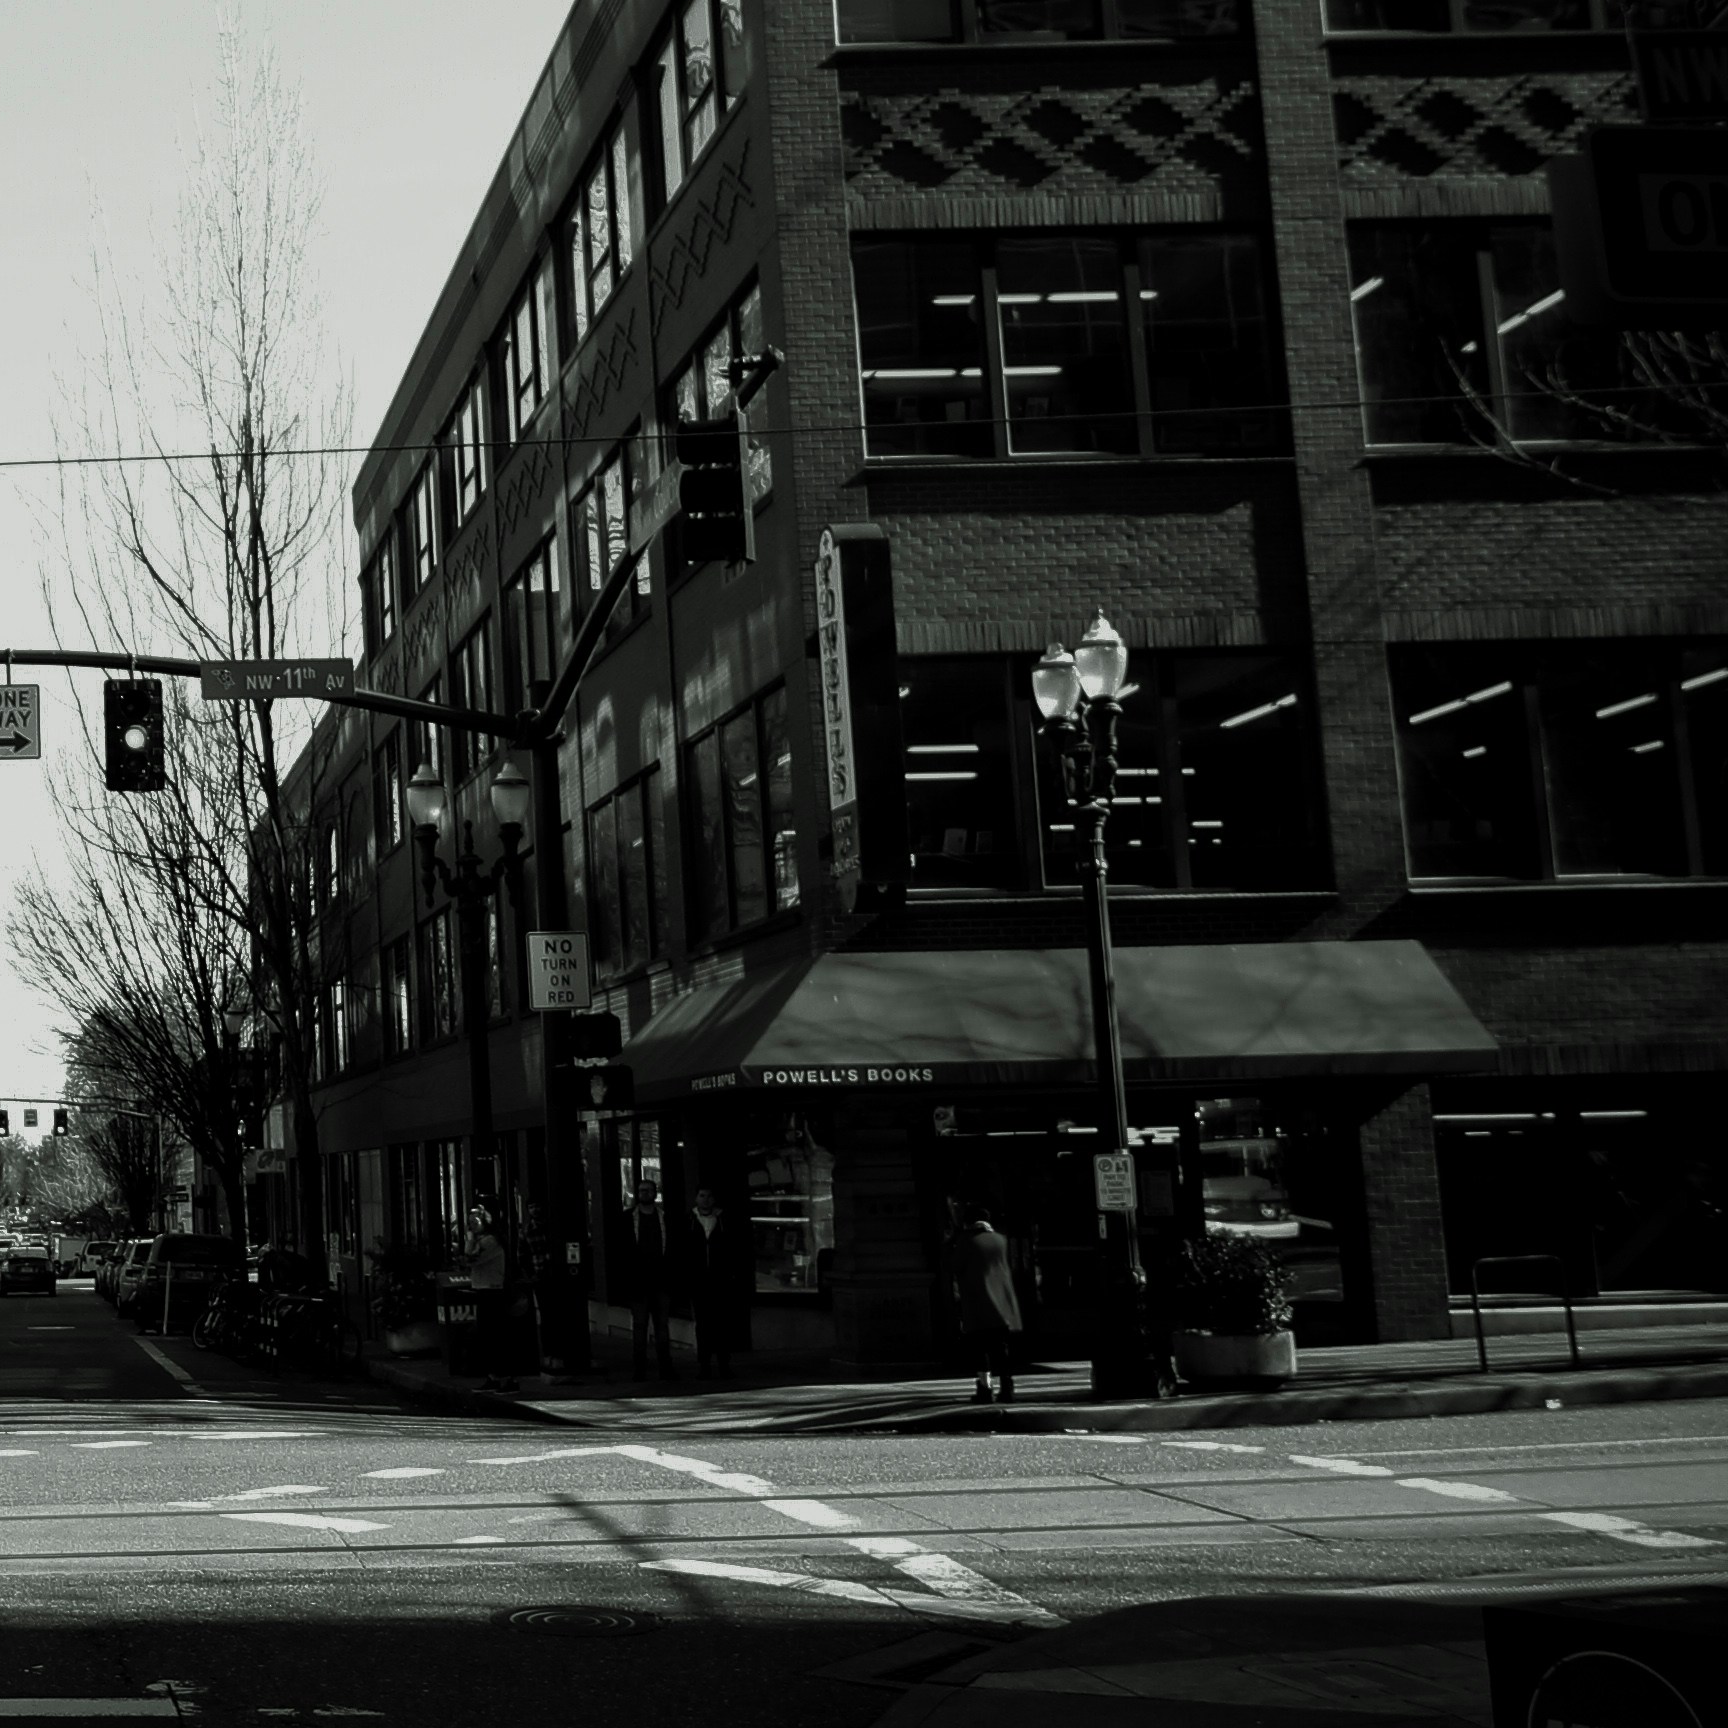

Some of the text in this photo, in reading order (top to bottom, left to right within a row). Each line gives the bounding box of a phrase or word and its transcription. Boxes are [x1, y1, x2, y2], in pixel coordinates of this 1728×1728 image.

[246, 666, 345, 690] NW 11th Av
[544, 939, 572, 954] NO
[541, 958, 577, 970] TURN
[550, 975, 570, 986] ON
[548, 991, 574, 1003] RED
[763, 1068, 934, 1084] POWELL'S BOOKS
